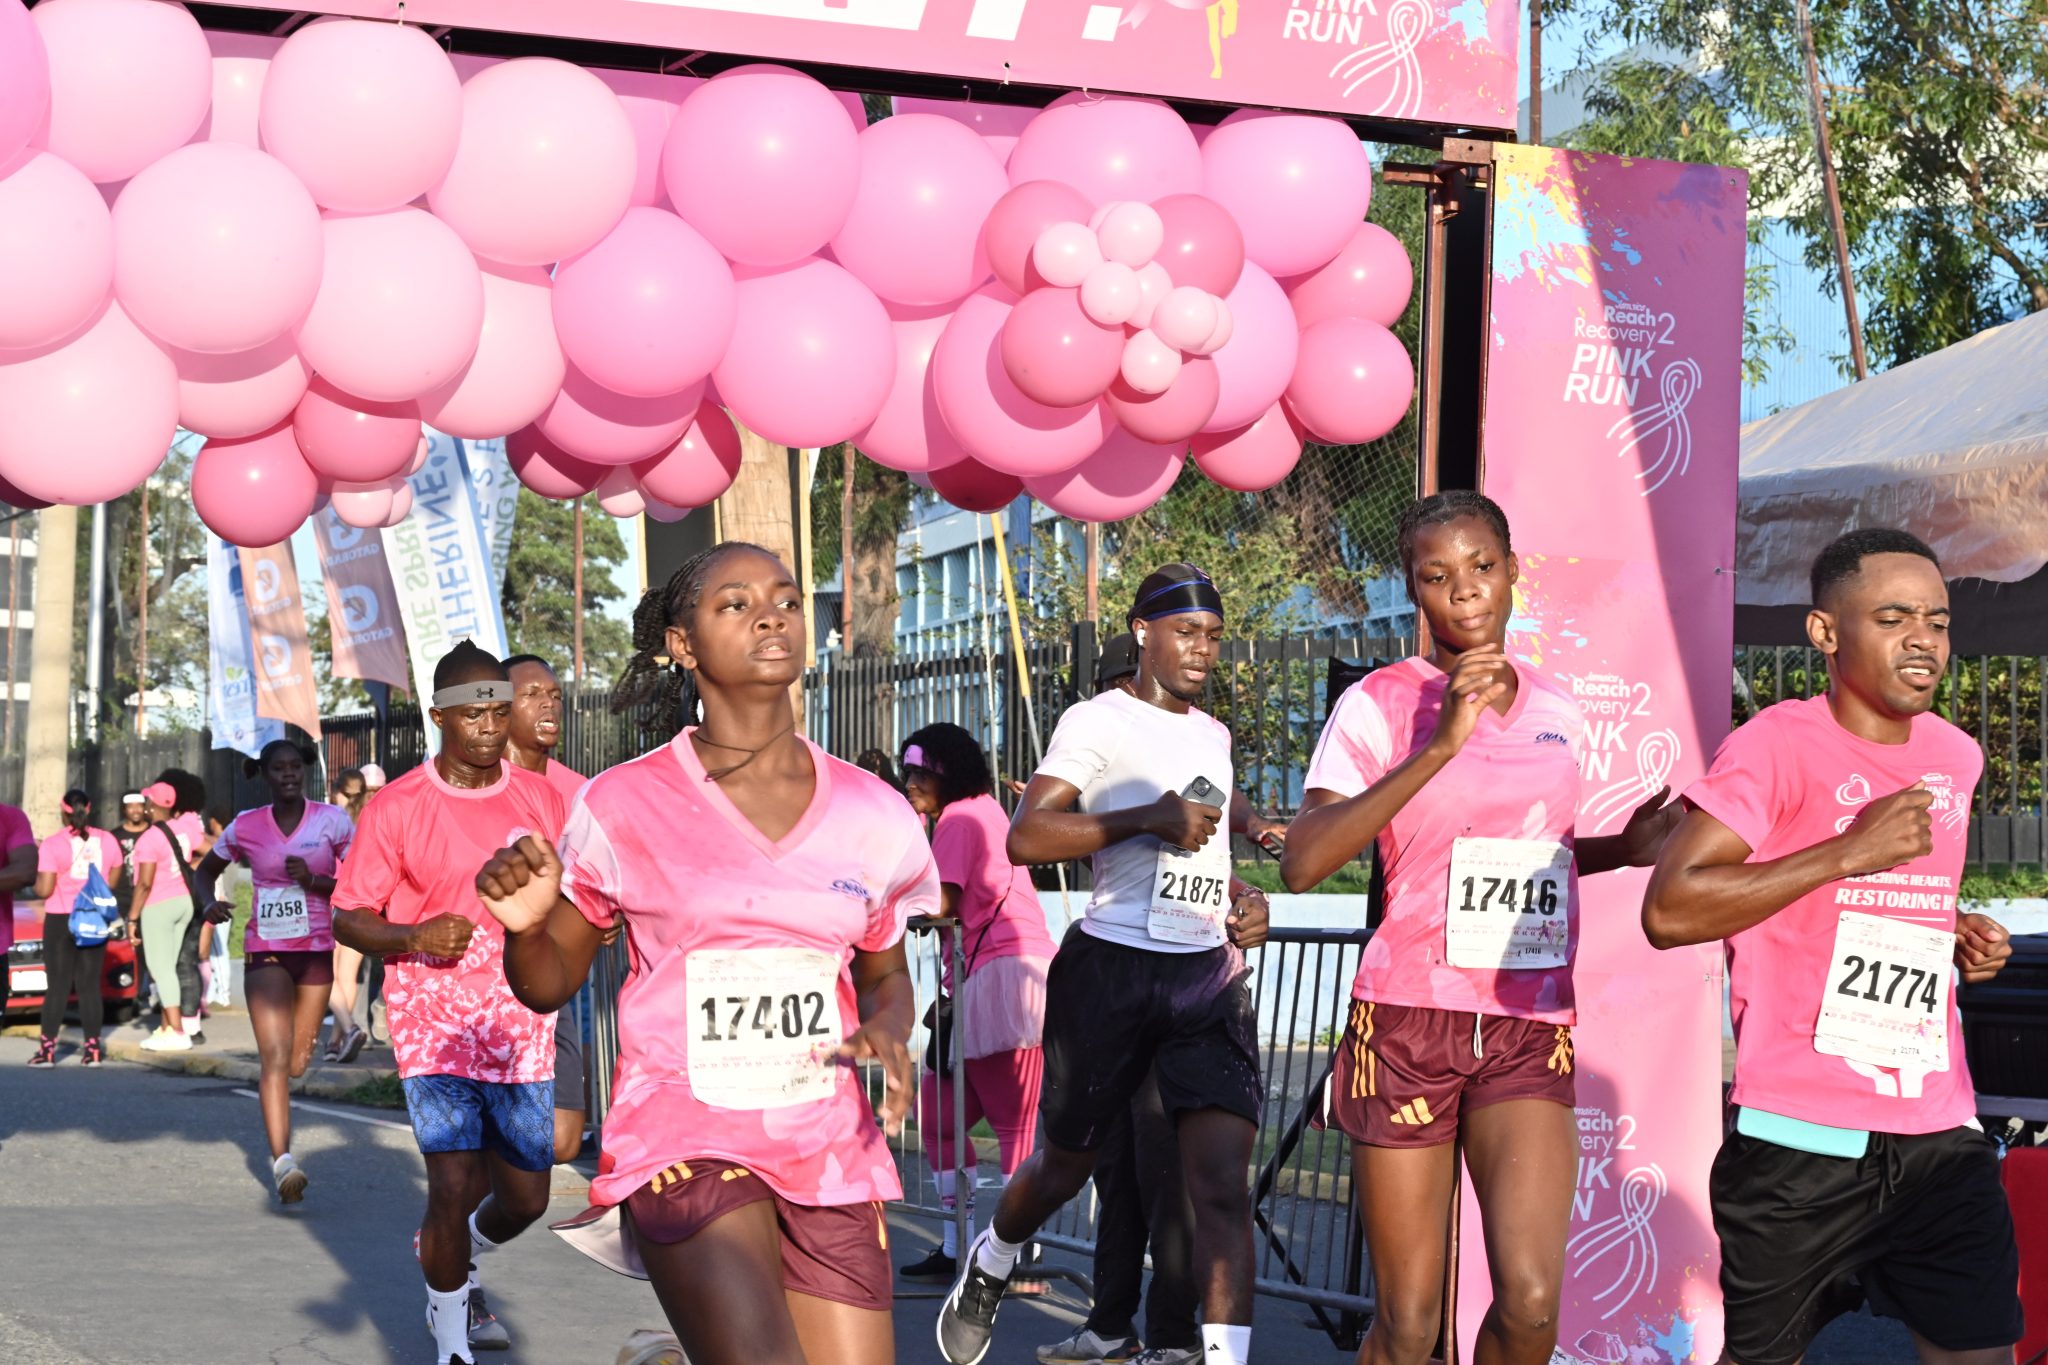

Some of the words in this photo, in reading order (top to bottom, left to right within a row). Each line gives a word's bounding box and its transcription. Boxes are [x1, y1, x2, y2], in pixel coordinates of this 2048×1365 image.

[1282, 8, 1363, 45] RUN
[1574, 316, 1656, 349] Recovery
[1603, 305, 1656, 327] Reach
[1657, 312, 1676, 345] 2
[1571, 343, 1656, 378] PINK
[1563, 372, 1640, 406] RUN
[1572, 678, 1631, 699] Reach
[1632, 682, 1652, 716] 2
[1578, 699, 1631, 721] overy
[1582, 720, 1631, 752] NK
[1159, 871, 1224, 906] 21875
[1459, 876, 1558, 916] 17416
[1834, 887, 1940, 910] RESTORING
[260, 900, 303, 919] 17358
[458, 938, 499, 976] 2025
[1836, 954, 1939, 1014] 21774
[700, 990, 831, 1042] 17402
[1576, 1111, 1614, 1132] ach
[1616, 1114, 1637, 1150] 2
